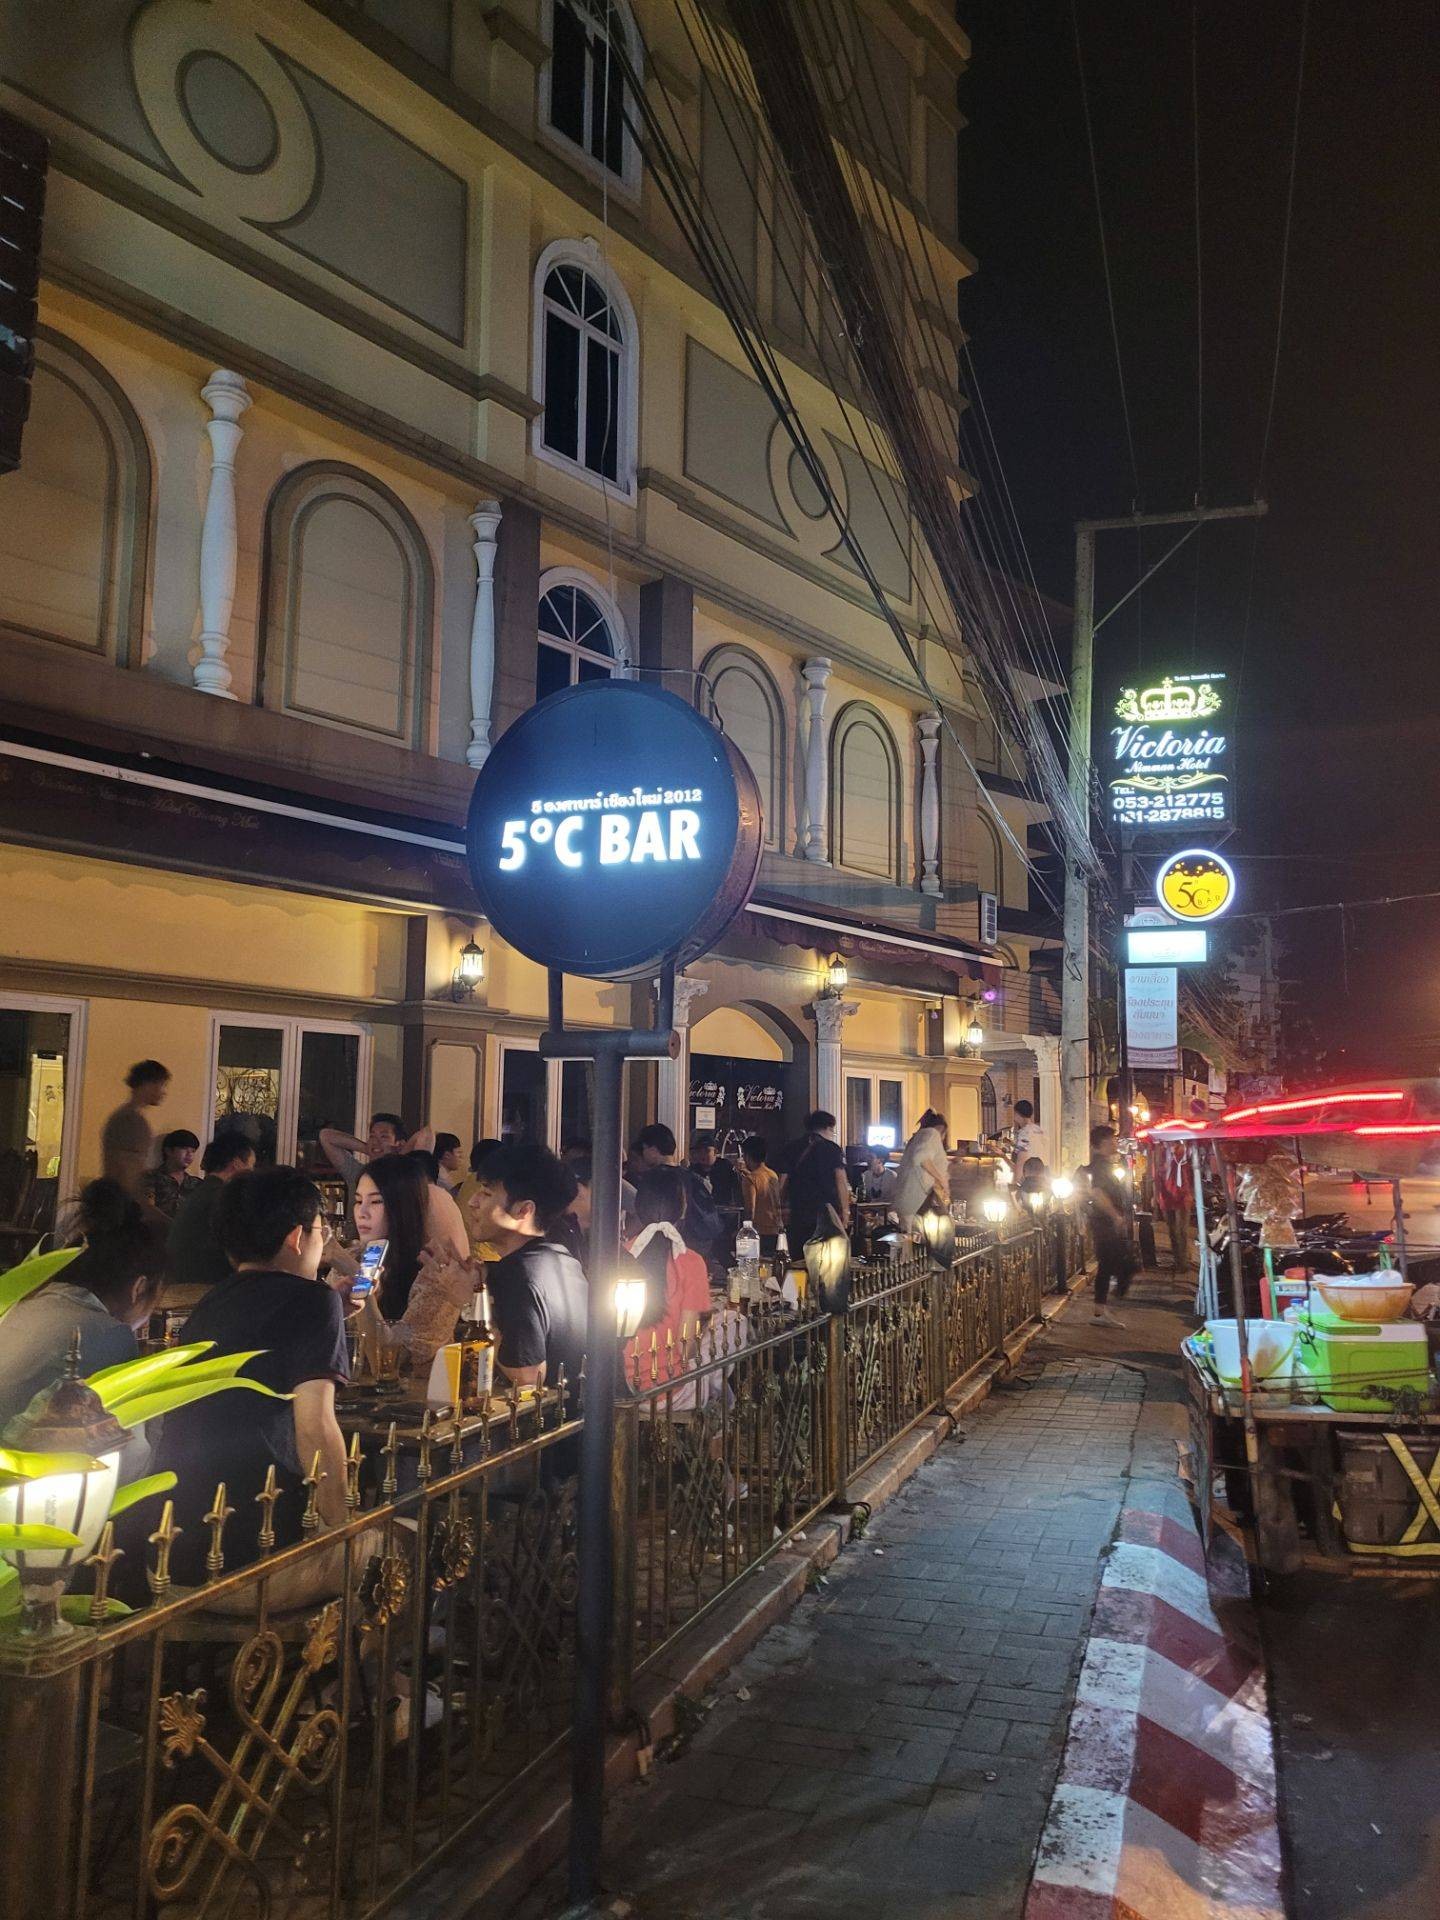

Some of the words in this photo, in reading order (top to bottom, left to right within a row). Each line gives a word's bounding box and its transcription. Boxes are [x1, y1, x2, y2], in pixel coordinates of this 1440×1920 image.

[1110, 724, 1226, 760] Victoria
[1177, 757, 1211, 771] Hotel
[604, 787, 662, 808] เชียงใหม่
[664, 788, 703, 804] 2012
[1112, 792, 1224, 810] 053-212775
[599, 809, 702, 865] BAR
